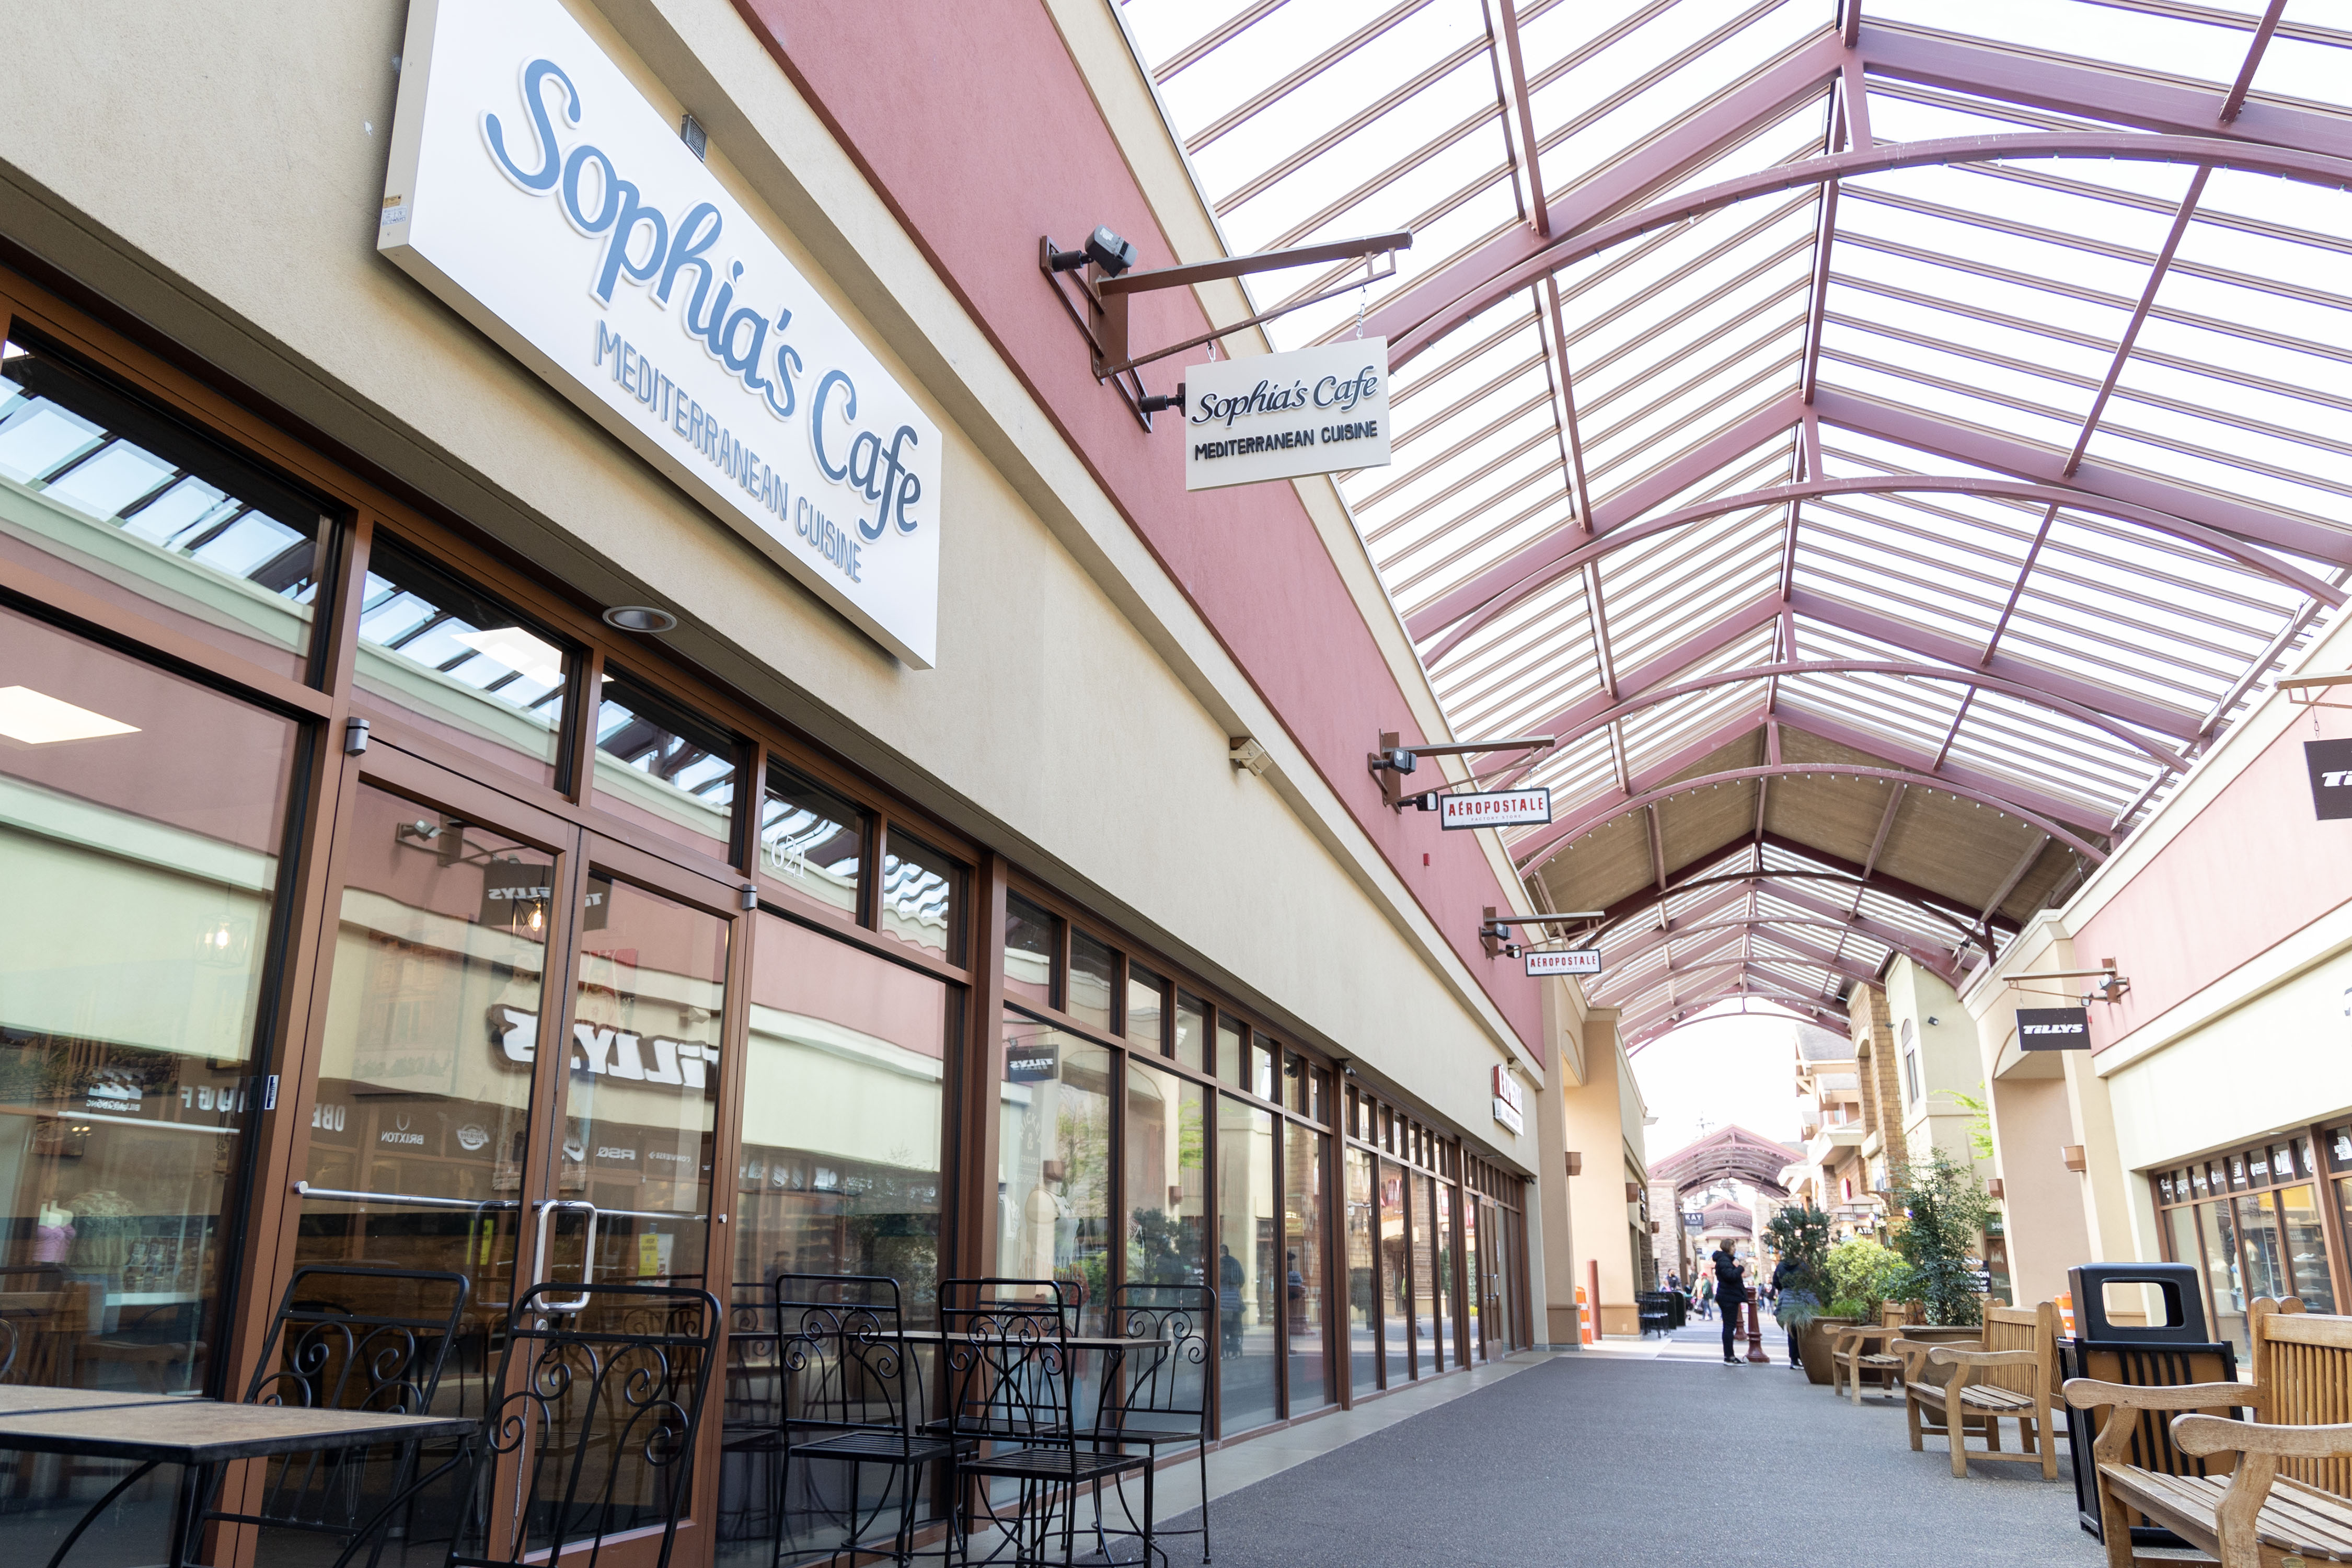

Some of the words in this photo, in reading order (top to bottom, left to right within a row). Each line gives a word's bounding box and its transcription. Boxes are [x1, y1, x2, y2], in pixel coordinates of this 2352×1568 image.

[485, 59, 803, 418] Sophia's
[812, 369, 921, 540] Cafe
[1192, 379, 1308, 426] Sophia's
[1313, 365, 1377, 410] Cafe
[595, 319, 789, 522] MEDITERRANEAN
[795, 496, 863, 584] CUISINE
[1195, 429, 1315, 460] MEDITERRANEAN
[1321, 420, 1378, 443] CUISINE
[1448, 797, 1544, 816] AÉROPOSTALE
[770, 831, 807, 880] 621
[1530, 955, 1596, 967] AÉROPOSTALE
